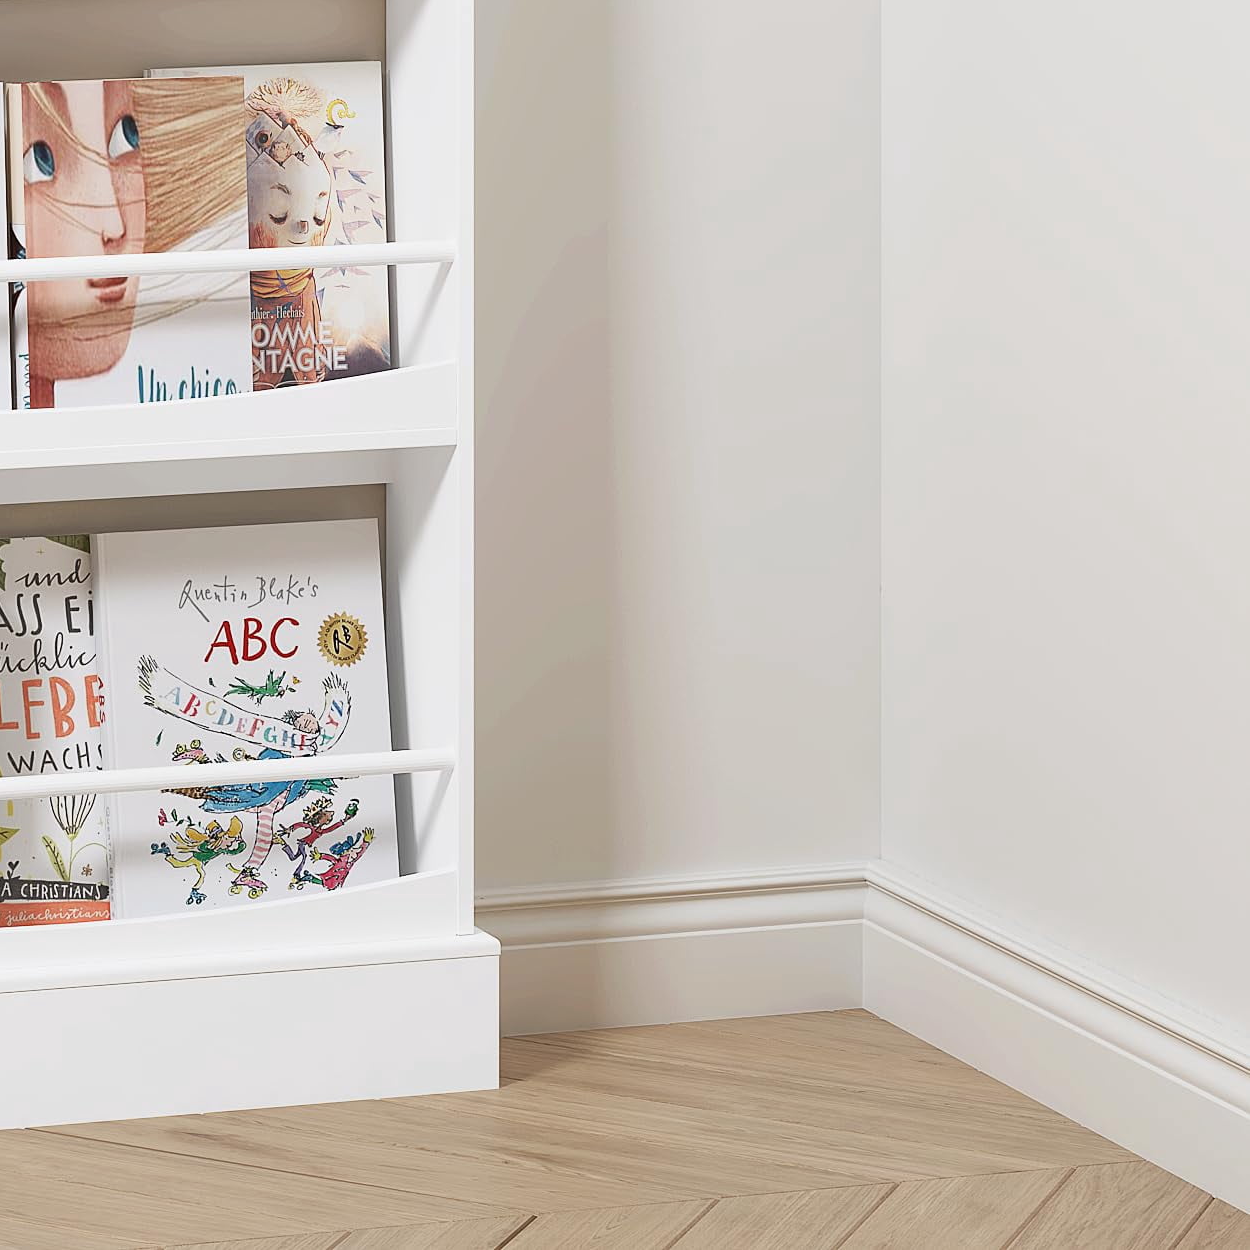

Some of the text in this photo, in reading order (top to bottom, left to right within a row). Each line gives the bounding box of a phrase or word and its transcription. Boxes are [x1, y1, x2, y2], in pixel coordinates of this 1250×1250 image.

[276, 305, 306, 318] Fléchais
[138, 365, 170, 403] Un
[15, 558, 90, 587] und
[179, 574, 319, 623] Quentin Blake's
[204, 617, 300, 665] ABC
